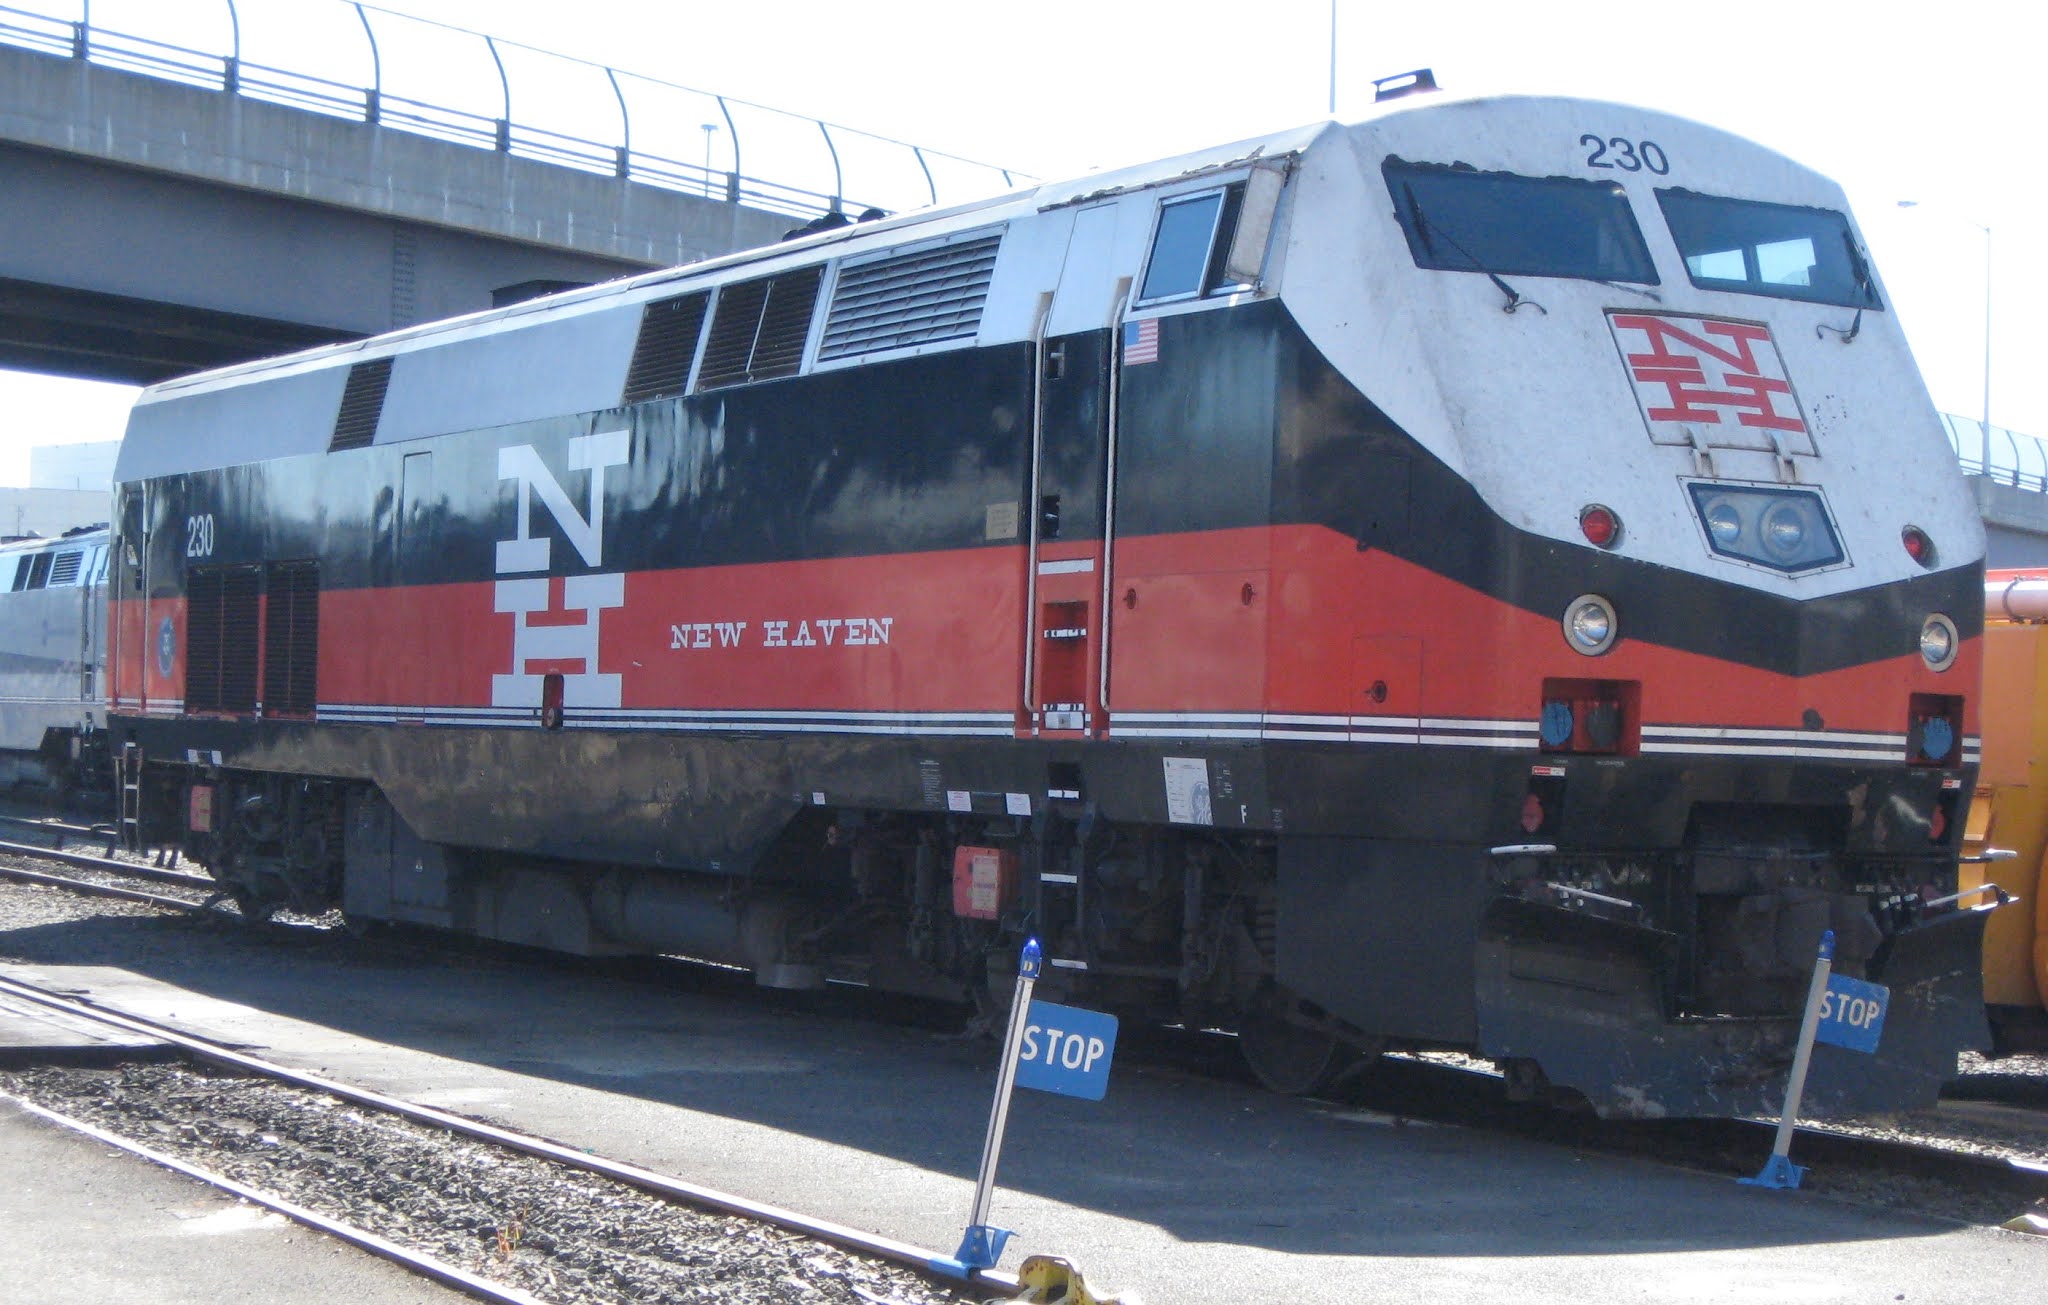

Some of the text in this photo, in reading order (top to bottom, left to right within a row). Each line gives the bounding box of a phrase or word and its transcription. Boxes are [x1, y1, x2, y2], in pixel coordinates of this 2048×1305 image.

[1580, 134, 1669, 175] 230
[187, 513, 214, 558] 230
[671, 617, 893, 649] NEW HAVEN
[1819, 990, 1880, 1029] STOP
[1020, 1024, 1105, 1073] STOP
